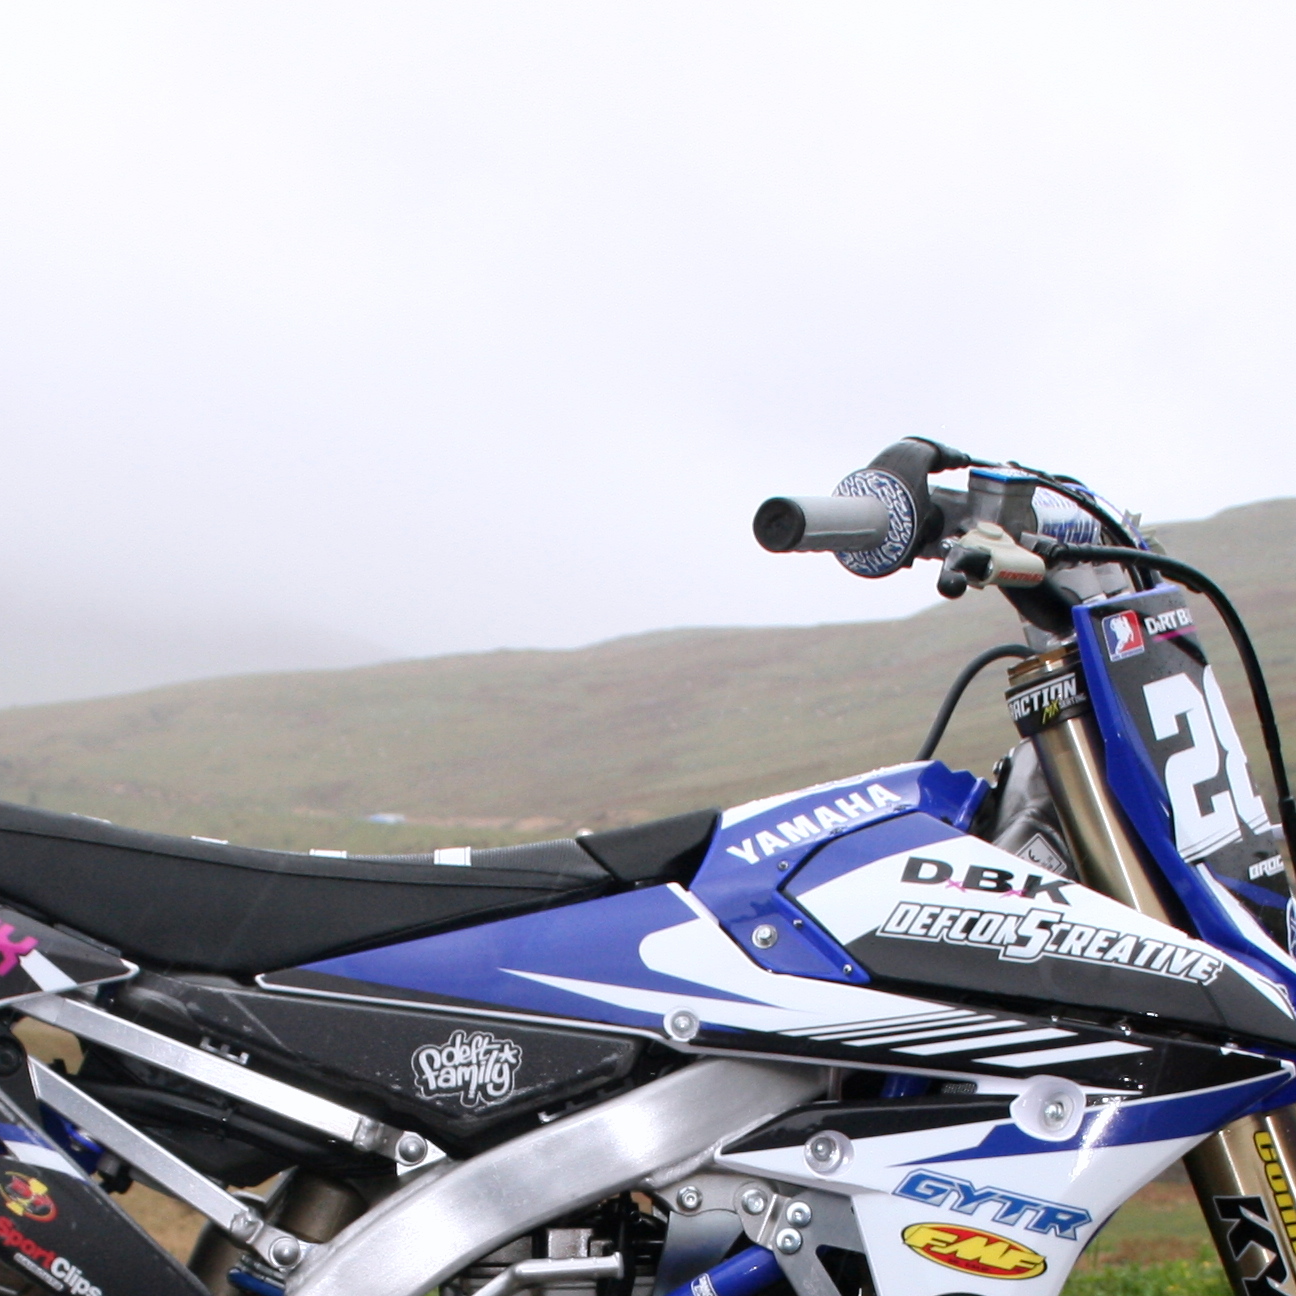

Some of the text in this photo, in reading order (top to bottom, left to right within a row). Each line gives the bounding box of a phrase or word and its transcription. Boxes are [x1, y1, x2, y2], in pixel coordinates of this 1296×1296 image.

[726, 783, 901, 864] YAMAHA
[419, 1048, 510, 1099] family
[442, 1034, 502, 1067] deft
[892, 1168, 1093, 1241] GYTR
[903, 1225, 1047, 1271] FMF
